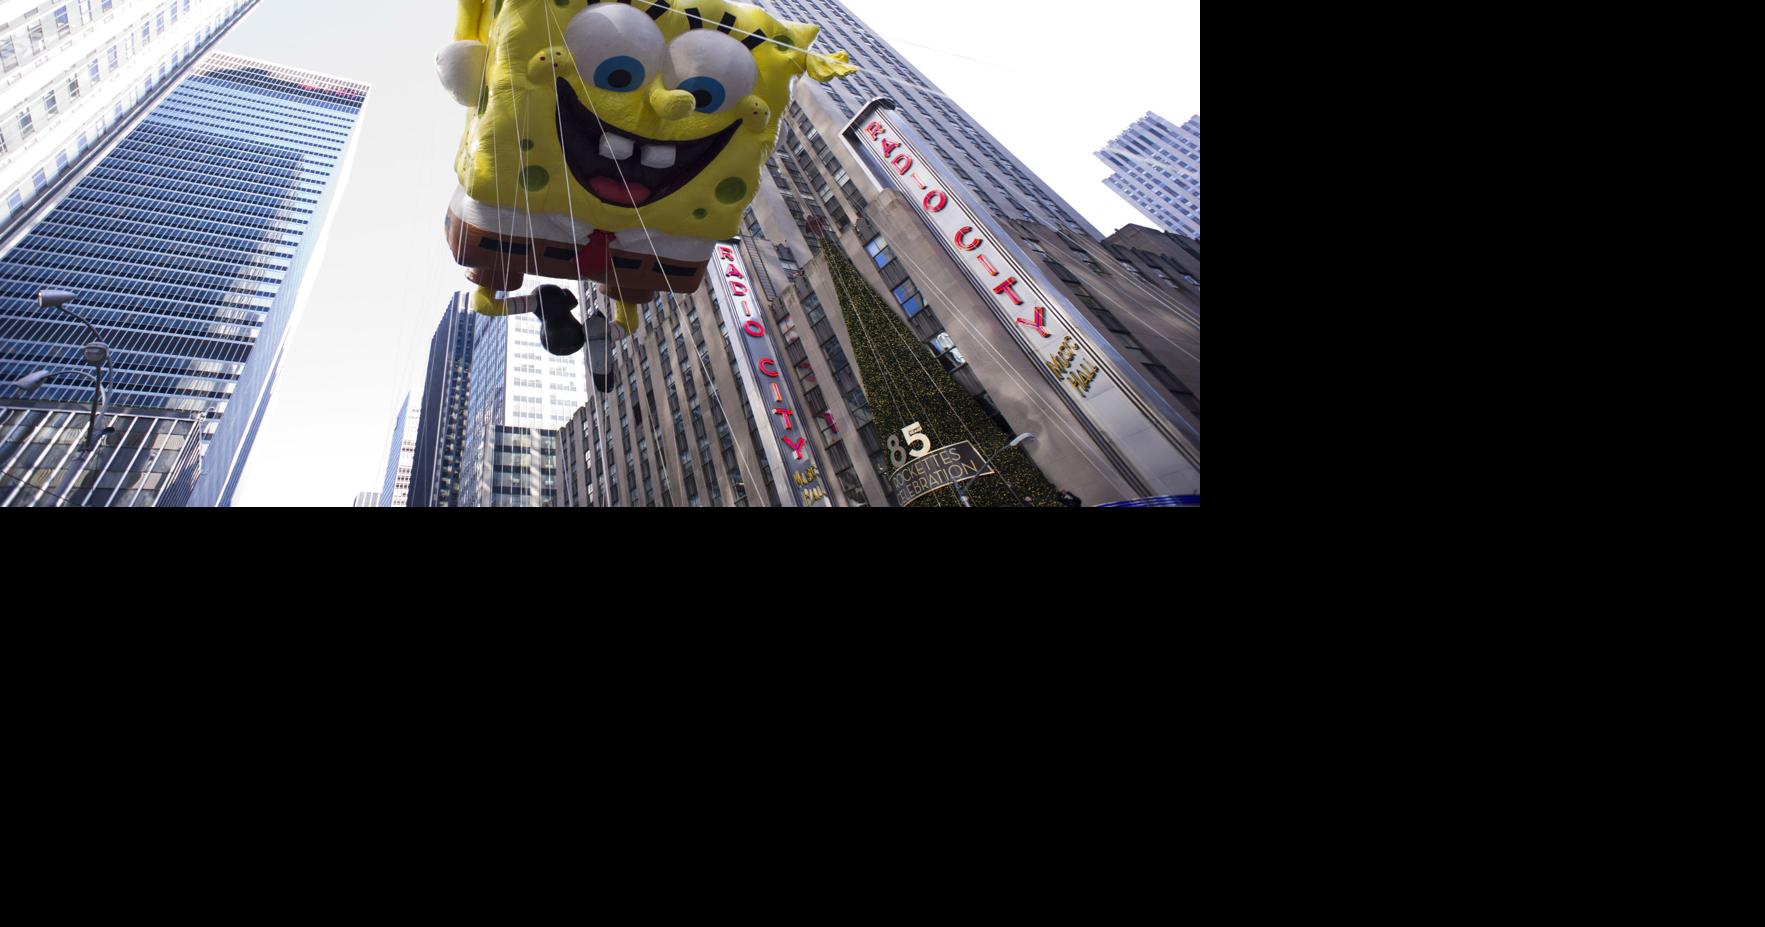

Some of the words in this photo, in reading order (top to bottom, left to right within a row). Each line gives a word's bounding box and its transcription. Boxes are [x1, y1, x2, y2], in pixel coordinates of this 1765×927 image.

[864, 120, 947, 213] RADIO
[954, 226, 1051, 338] CITY
[718, 246, 765, 337] RADIO
[758, 357, 806, 460] CITY
[1045, 336, 1080, 381] MUSIC
[1067, 358, 1099, 398] HALL
[886, 421, 931, 468] 85
[892, 448, 961, 489] ROCKETTES
[896, 460, 978, 506] CELEBRATION
